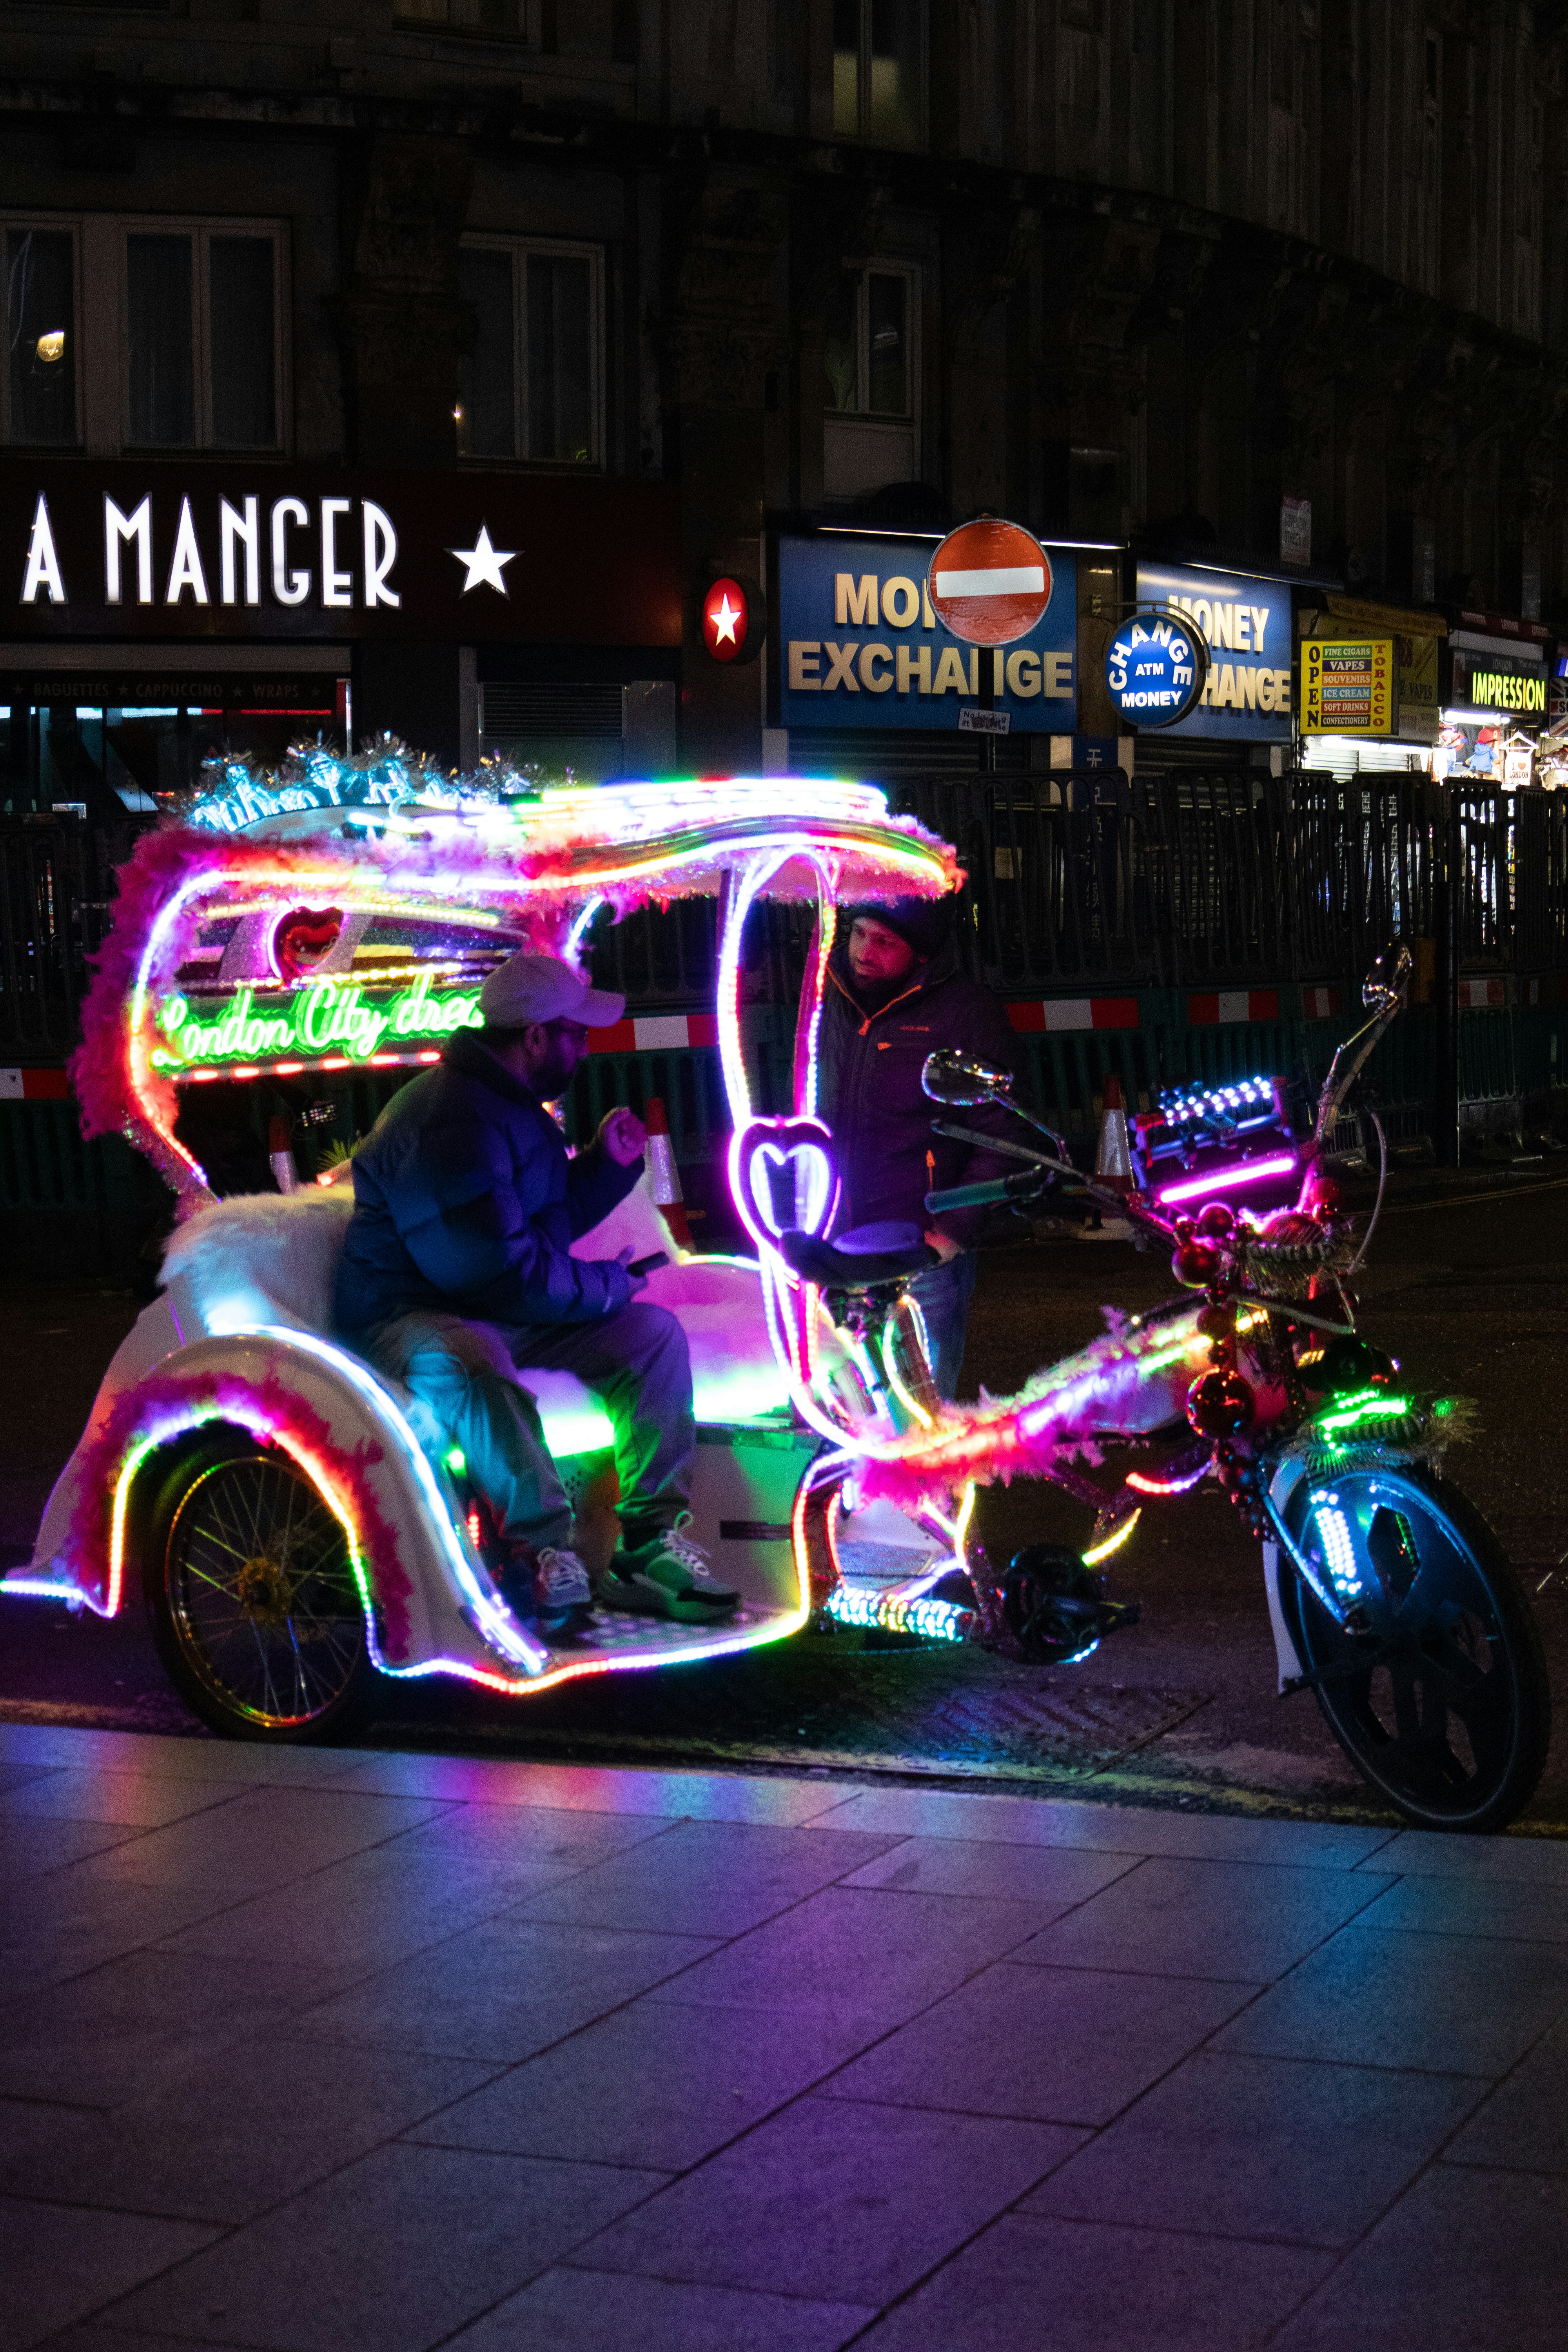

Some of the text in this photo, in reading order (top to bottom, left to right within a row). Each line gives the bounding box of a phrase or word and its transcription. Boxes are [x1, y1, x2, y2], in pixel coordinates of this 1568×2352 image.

[19, 491, 401, 609] A MANGER
[1109, 620, 1192, 691] CHANGE
[1325, 648, 1370, 656] FINE CIGARS
[1135, 662, 1164, 676] ATM
[1330, 661, 1365, 670] VAPES
[1307, 646, 1320, 727] OPEN
[1323, 675, 1370, 684] SOUVENIRS
[1372, 645, 1386, 726] TOBACCO
[34, 682, 299, 698] BAGUETTES CAPPUCCINO WRAPS
[1198, 663, 1291, 713] HANGE
[1323, 689, 1370, 698] ICE CREAM
[1472, 671, 1545, 711] IMPRESSION
[1121, 691, 1183, 708] MONEY
[1324, 702, 1368, 711] SOFT DRINKS
[1323, 717, 1368, 725] CONFECTIONERY
[152, 973, 485, 1066] London City drea
